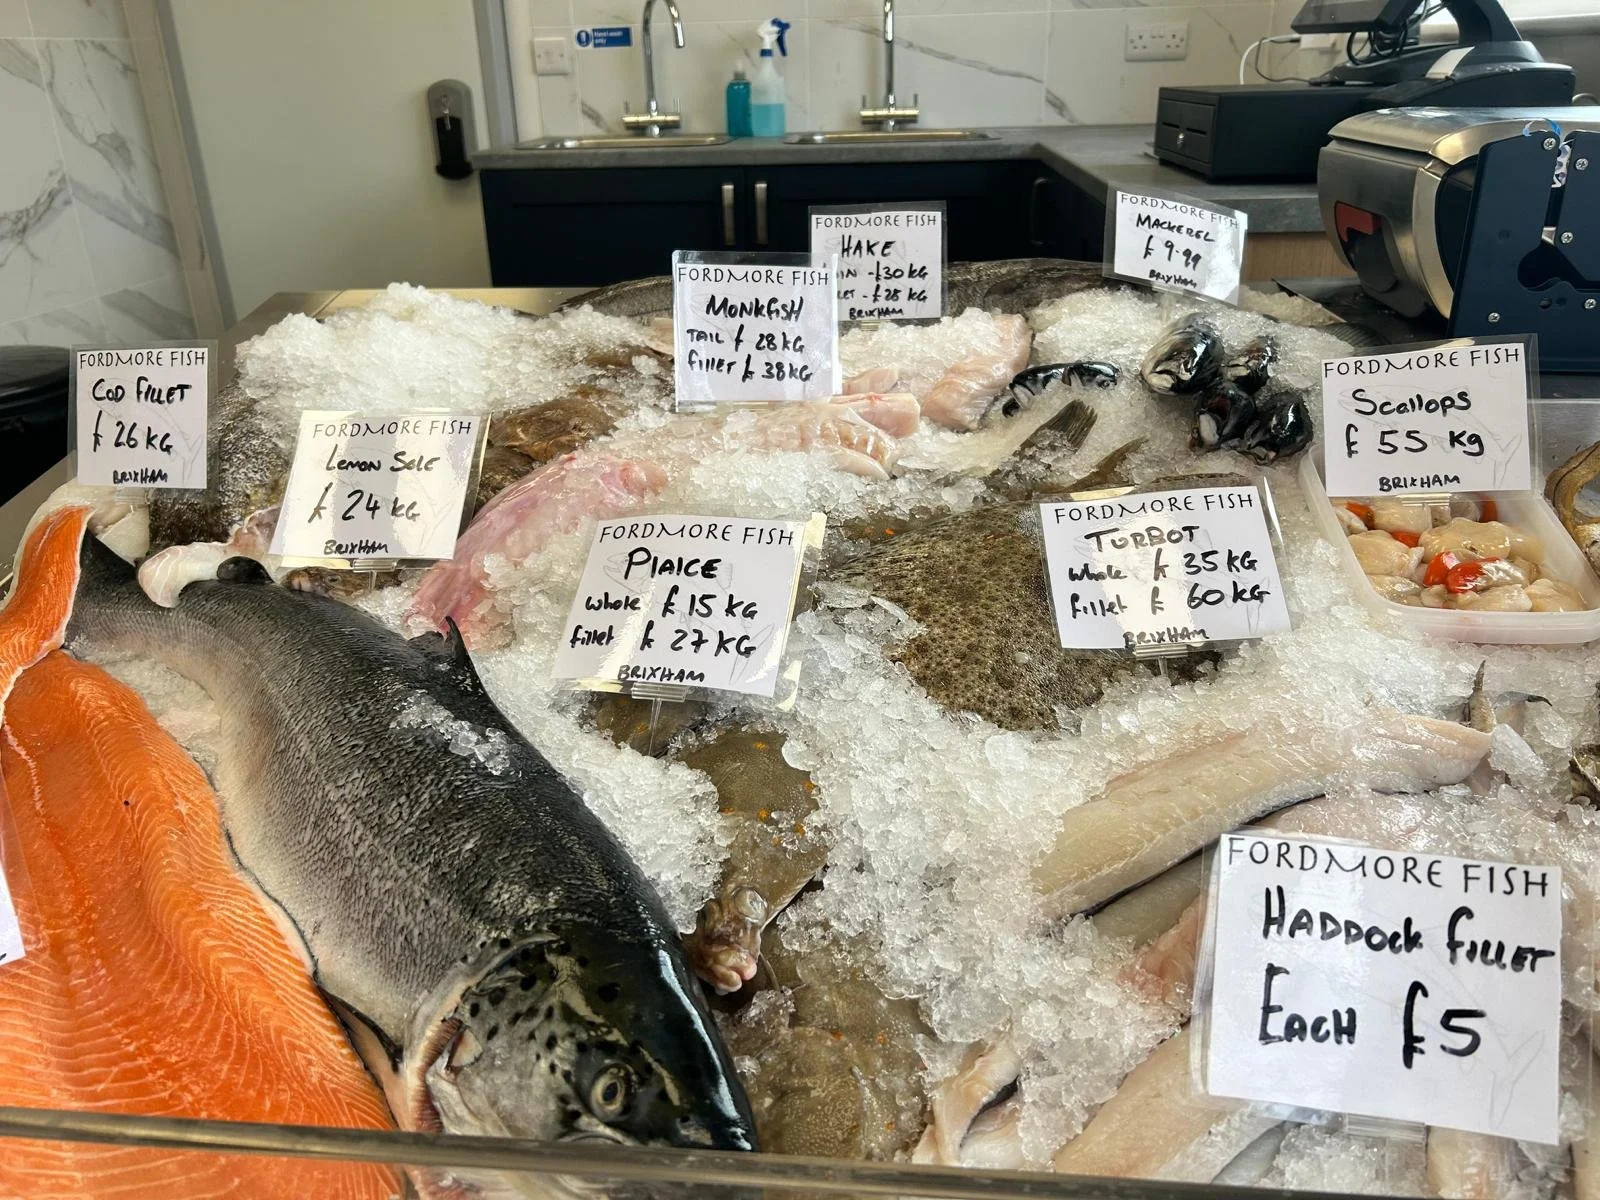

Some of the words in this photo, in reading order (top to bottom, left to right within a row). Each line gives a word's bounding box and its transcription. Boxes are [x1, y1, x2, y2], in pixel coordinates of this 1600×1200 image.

[815, 215, 900, 229] FORDMORE
[906, 214, 937, 227] FISH
[1121, 193, 1204, 220] FORDMORE
[1210, 213, 1239, 229] FISH
[1136, 213, 1215, 242] MACKEREL
[841, 234, 896, 259] HAKE
[678, 267, 784, 285] FORDMORE
[792, 270, 829, 286] FISH
[705, 295, 804, 322] MONKFISH
[849, 307, 904, 320] BRIXHAM
[686, 328, 725, 344] TAIL
[80, 351, 164, 369] FORDMORE
[171, 350, 205, 367] FISH
[1324, 352, 1459, 378] FORDMORE
[1470, 348, 1520, 367] FISH
[1351, 388, 1472, 417] Scallops
[313, 420, 423, 438] FORDMORE
[429, 419, 472, 435] FISH
[1377, 430, 1428, 455] 55
[113, 467, 168, 484] BRIXHAM
[1379, 474, 1461, 492] BRIXHAM
[1055, 495, 1195, 524] FORDMORE
[1204, 493, 1253, 511] FISH
[599, 522, 733, 543] FORDMORE
[742, 527, 794, 546] FISH
[1084, 525, 1200, 552] TURBOT
[323, 539, 389, 555] BRIXHAM
[1068, 563, 1128, 582] whole
[585, 592, 641, 611] whole
[1070, 593, 1128, 619] fillet
[570, 625, 615, 649] fillet
[1123, 627, 1210, 649] BRIXHAM
[617, 665, 705, 683] BRIXHAM
[1228, 837, 1443, 888] FORDMORE
[1463, 863, 1549, 898] FISH
